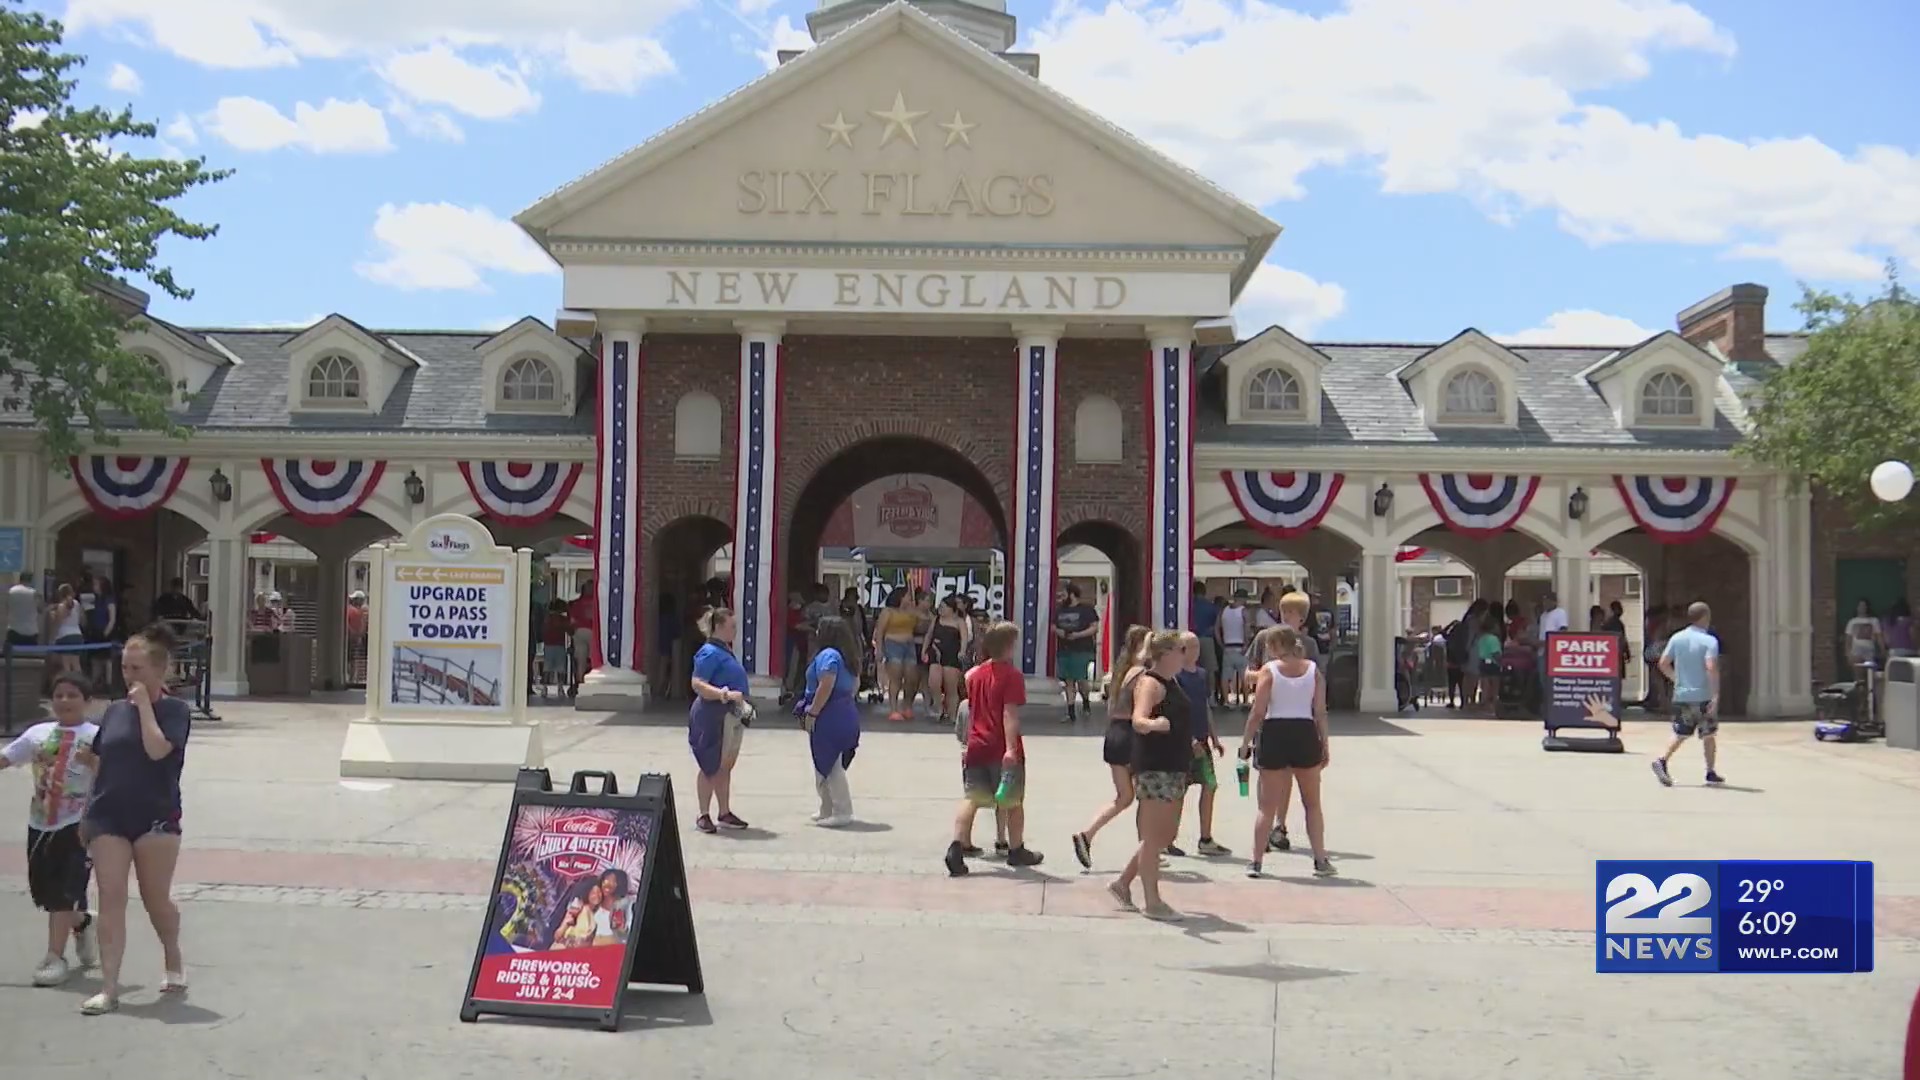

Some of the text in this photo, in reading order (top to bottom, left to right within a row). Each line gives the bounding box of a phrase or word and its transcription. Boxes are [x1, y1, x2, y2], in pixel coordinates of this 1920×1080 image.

[736, 170, 1057, 218] SIX FLAGS
[665, 271, 1128, 311] NEW ENGLAND
[430, 540, 470, 550] Six Flags
[410, 585, 487, 602] UPGRADE
[409, 604, 487, 621] TO A PASS
[408, 623, 488, 640] TODAY!
[1555, 640, 1610, 653] PARK
[1560, 654, 1606, 667] EXIT
[562, 819, 598, 834] Coca-Cola
[541, 836, 616, 859] JULY 4TH FEST
[557, 860, 592, 870] Six Flags
[509, 958, 593, 976] FIREWORKS,
[496, 970, 601, 989] RIDES & MUSIC
[516, 985, 575, 1000] JULY 2-4
